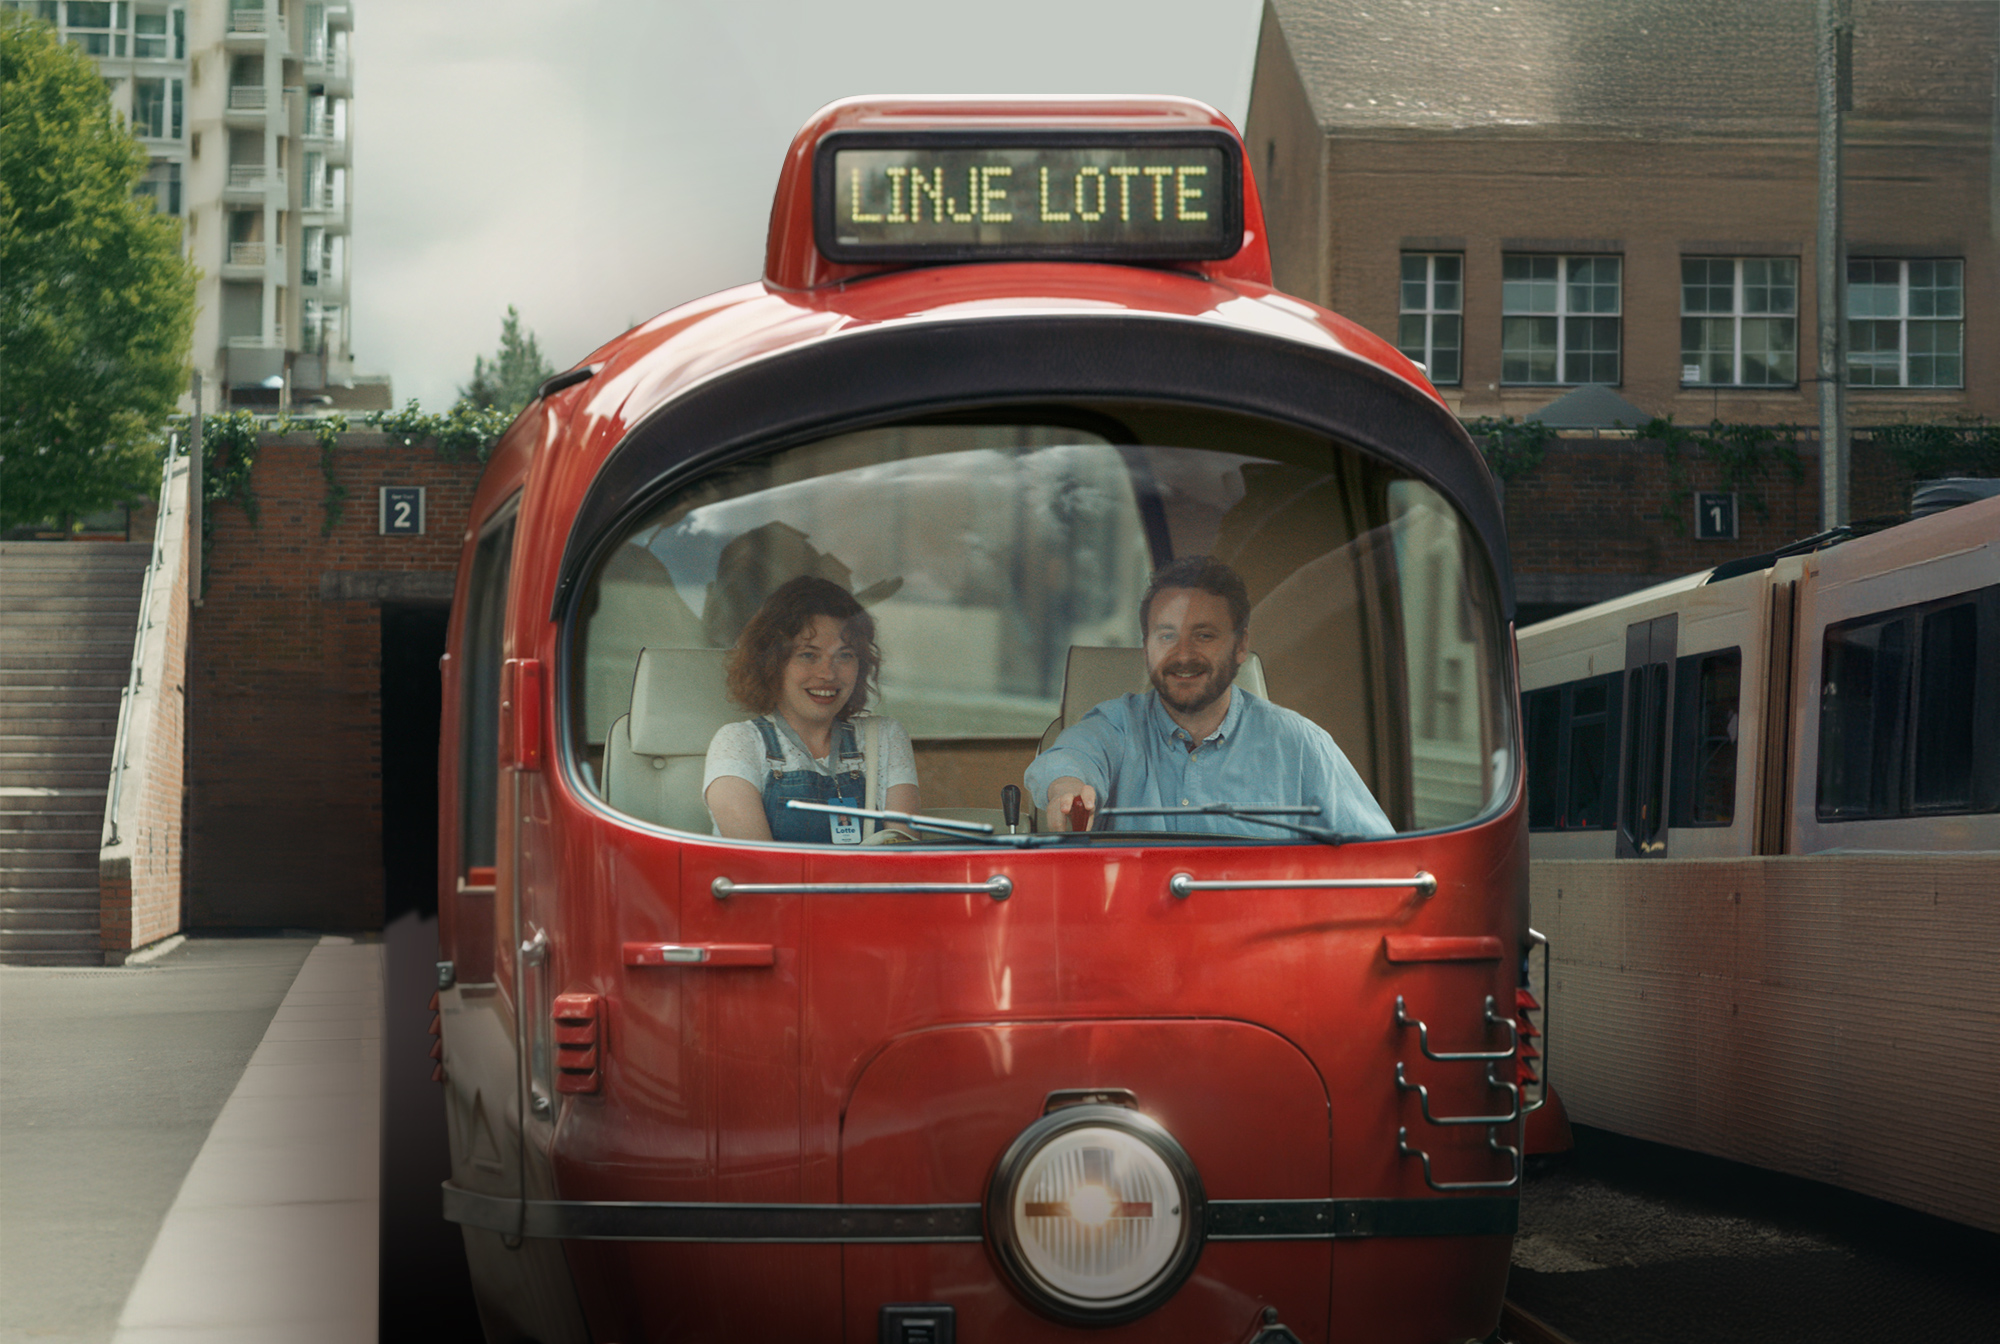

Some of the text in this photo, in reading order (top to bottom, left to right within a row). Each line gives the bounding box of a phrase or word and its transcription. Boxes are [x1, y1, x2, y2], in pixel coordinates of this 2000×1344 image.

[852, 166, 1208, 223] LINJE LOTTE
[394, 501, 411, 528] 2
[1710, 506, 1721, 532] 1
